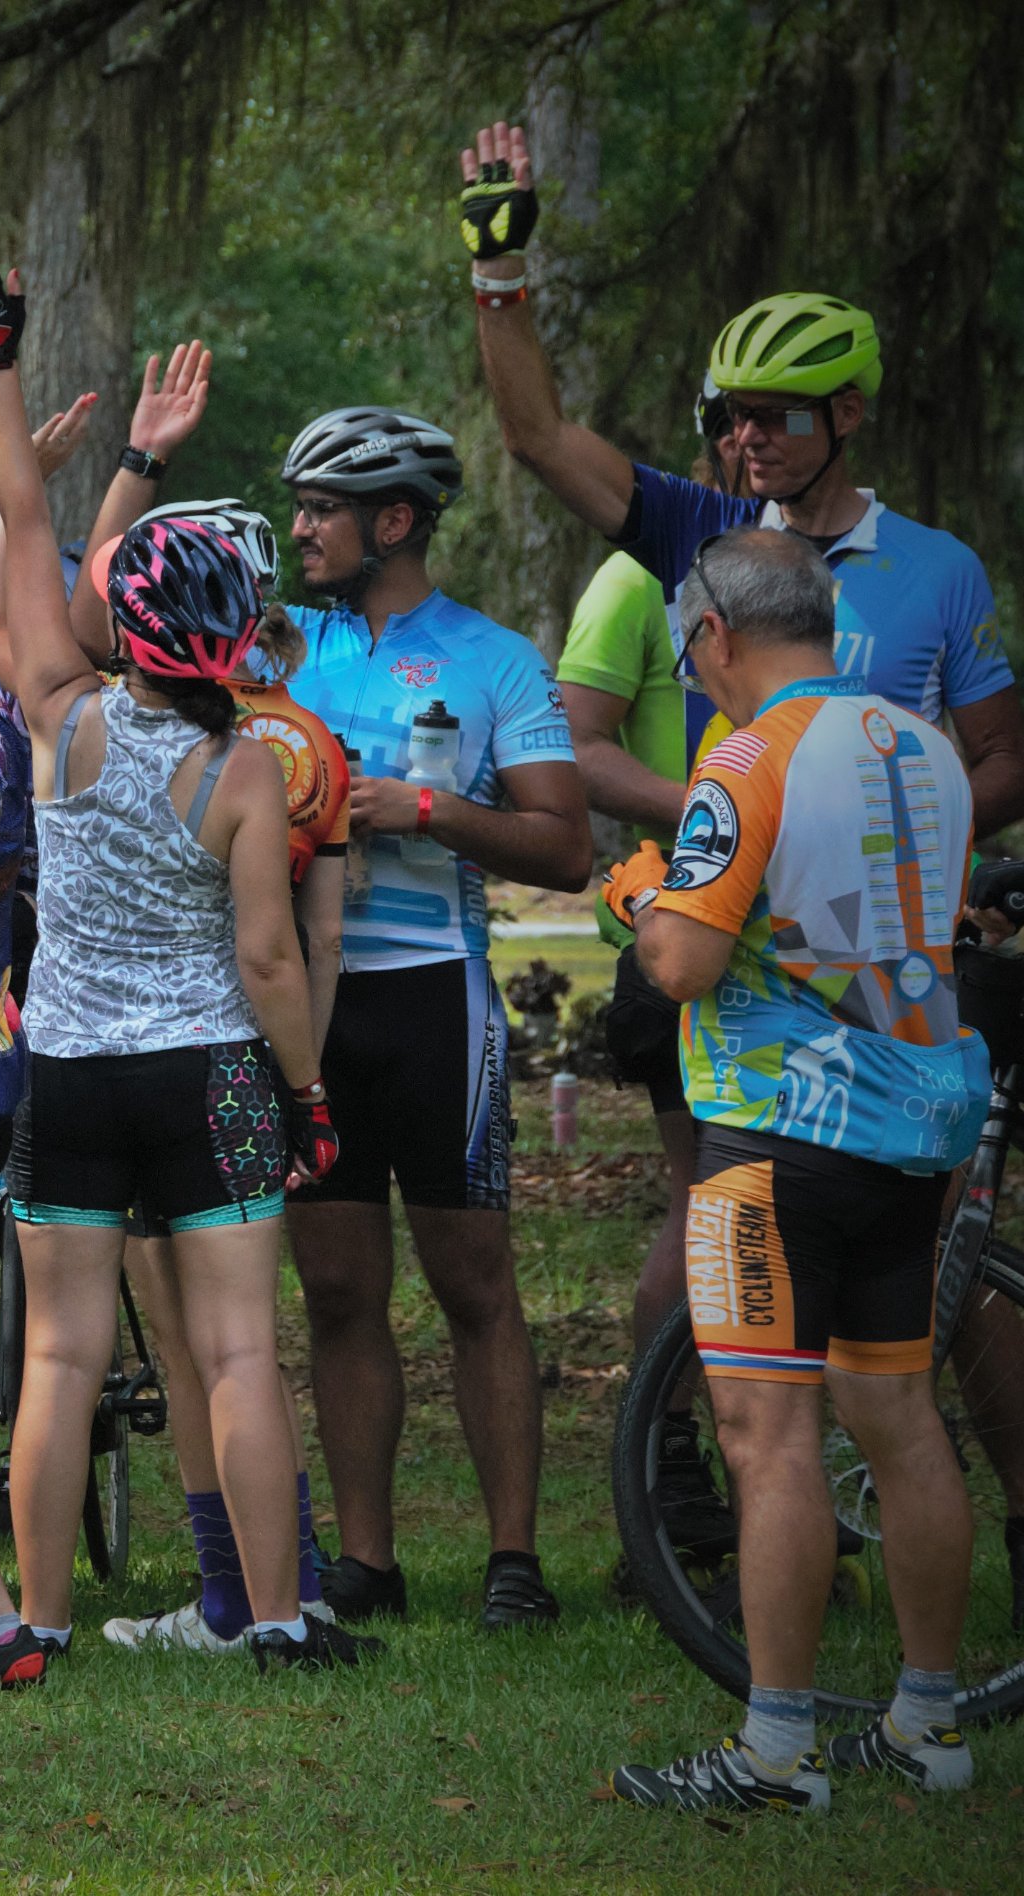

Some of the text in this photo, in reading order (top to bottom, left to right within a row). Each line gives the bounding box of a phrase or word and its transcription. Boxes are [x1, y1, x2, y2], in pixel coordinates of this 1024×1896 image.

[353, 438, 387, 457] 0445
[123, 588, 166, 633] KASK
[705, 788, 730, 827] PASSAGE
[485, 1020, 507, 1163] PERFORMANCE
[903, 1095, 946, 1123] Of
[685, 1192, 728, 1326] ORANGE
